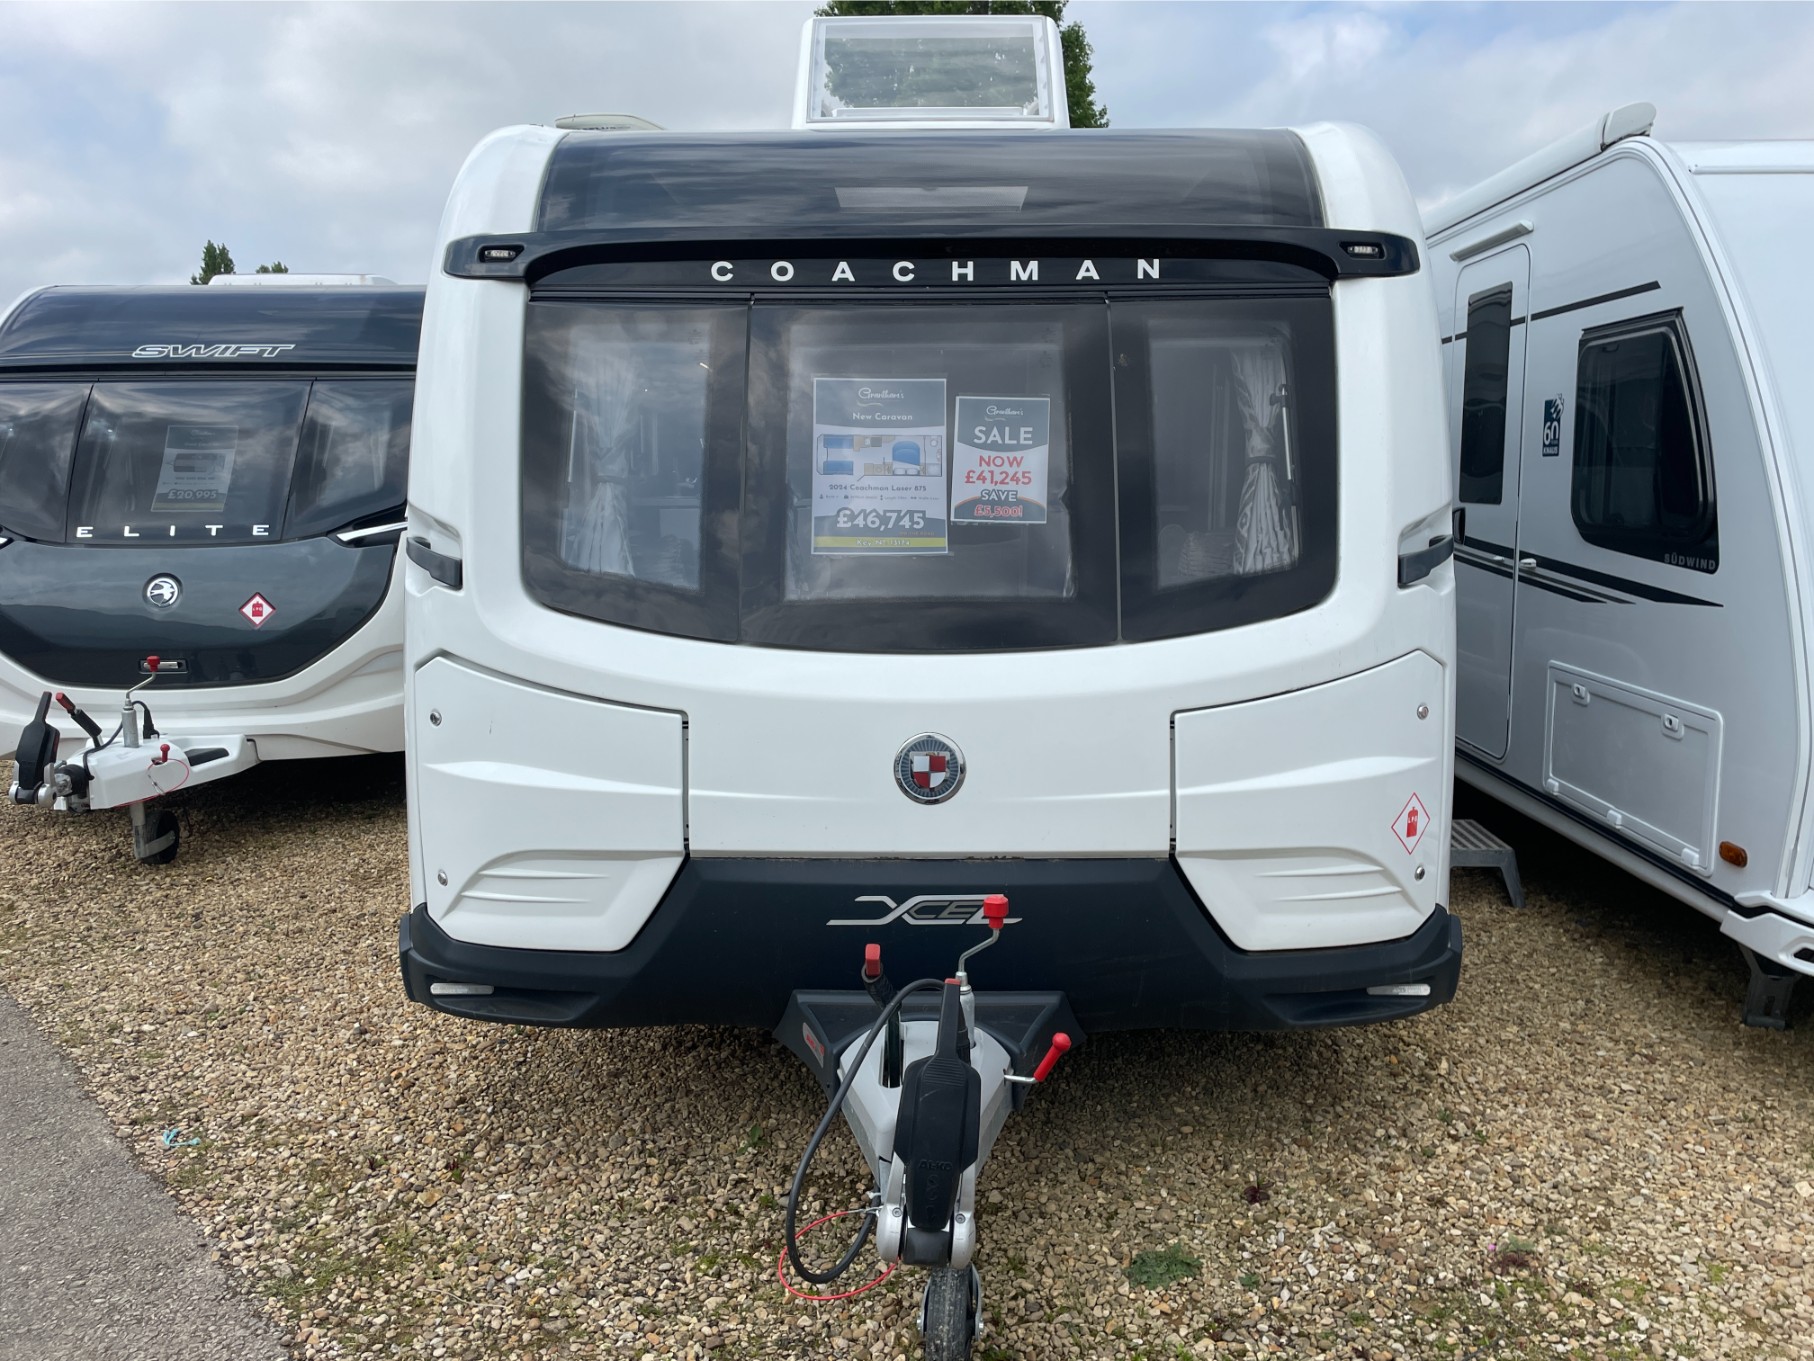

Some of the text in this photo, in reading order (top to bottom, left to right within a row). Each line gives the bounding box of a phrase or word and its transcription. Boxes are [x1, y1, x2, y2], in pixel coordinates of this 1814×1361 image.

[710, 258, 1160, 282] COACHMAN
[131, 343, 296, 358] SWIFT
[852, 412, 913, 421] New Caravan
[973, 425, 1033, 445] SALE
[978, 455, 1024, 468] NOW
[964, 469, 1032, 486] £41,245
[849, 483, 889, 491] Coachman
[891, 484, 912, 492] Laser
[981, 490, 1017, 502] SAVE
[836, 509, 925, 531] £46,745
[76, 524, 269, 539] ELITE
[1664, 552, 1716, 570] SÜDWIND
